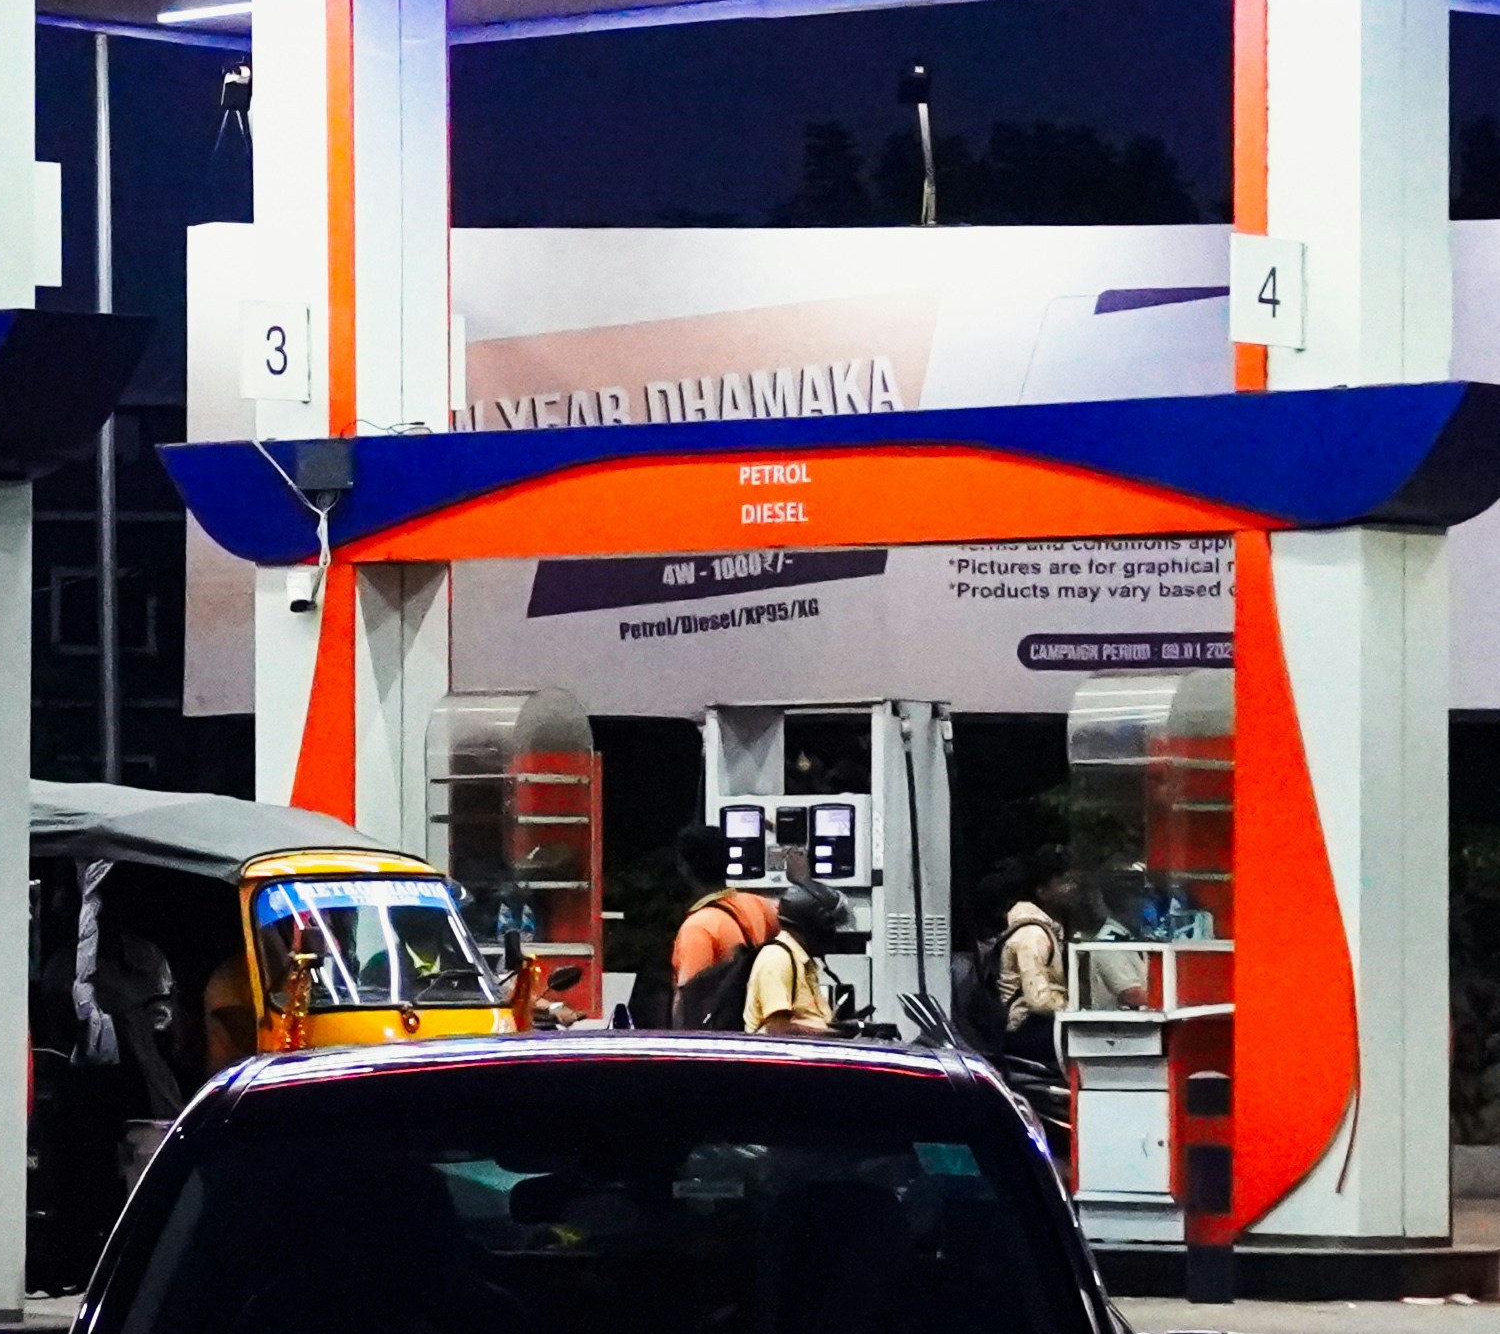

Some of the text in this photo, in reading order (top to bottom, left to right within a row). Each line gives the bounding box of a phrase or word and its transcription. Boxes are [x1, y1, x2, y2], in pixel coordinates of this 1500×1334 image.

[1257, 265, 1281, 319] 4
[265, 325, 289, 376] 3
[643, 355, 902, 424] DHAMAKA
[739, 463, 811, 485] PETROL
[741, 501, 809, 524] DIESEL
[1050, 562, 1082, 575] are
[1088, 558, 1117, 575] for
[1123, 558, 1220, 578] graphical
[1058, 586, 1101, 603] may
[1108, 583, 1151, 602] vary
[1159, 581, 1221, 597] based
[1030, 643, 1099, 660] CAMPAIGN
[1102, 643, 1151, 660] PERIOD
